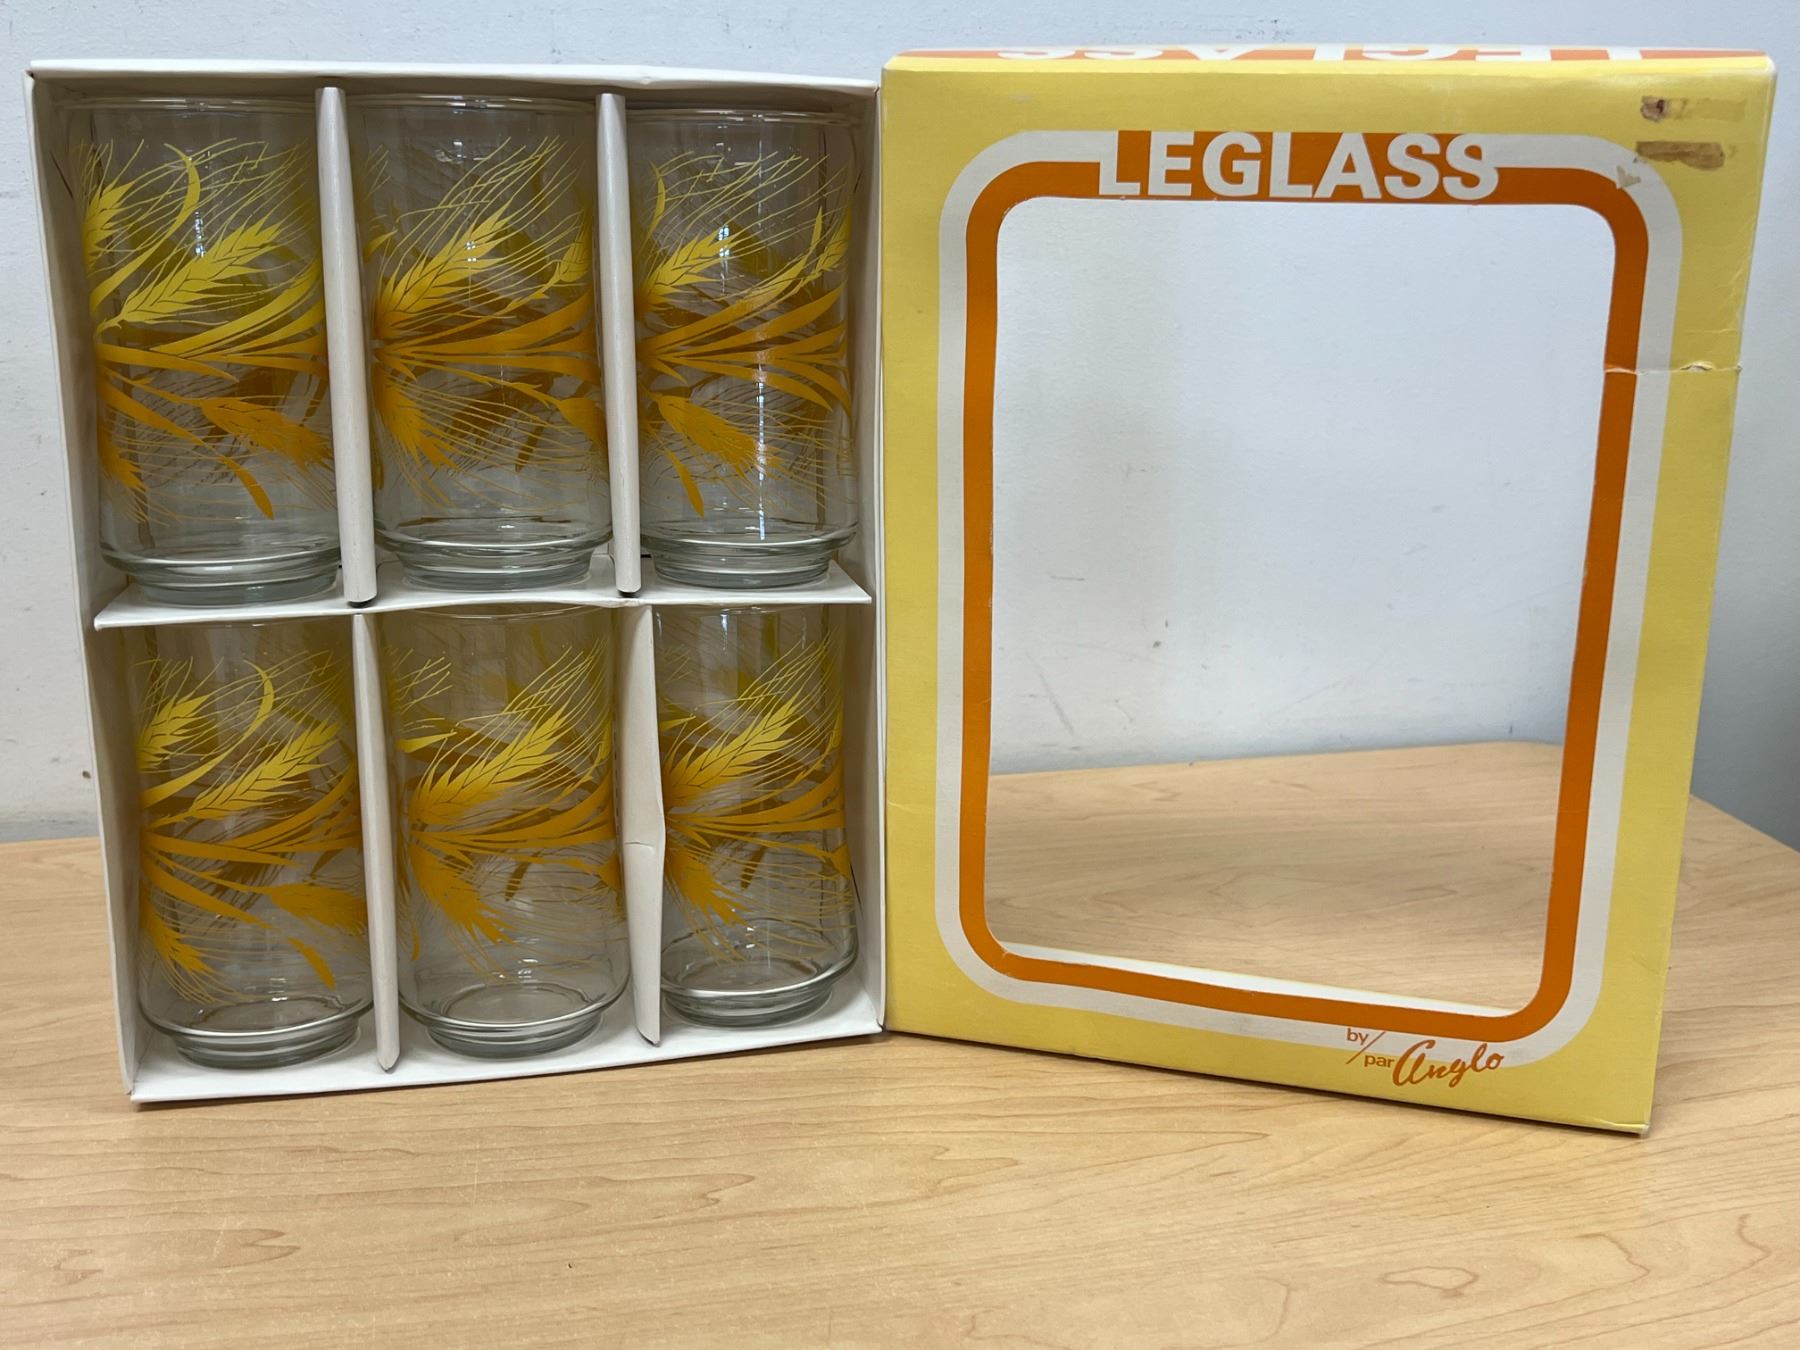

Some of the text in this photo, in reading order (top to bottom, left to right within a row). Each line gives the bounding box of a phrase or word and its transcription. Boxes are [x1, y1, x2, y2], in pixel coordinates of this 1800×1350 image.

[1099, 131, 1499, 200] LEGLASS
[1364, 1039, 1505, 1088] par Anglo
